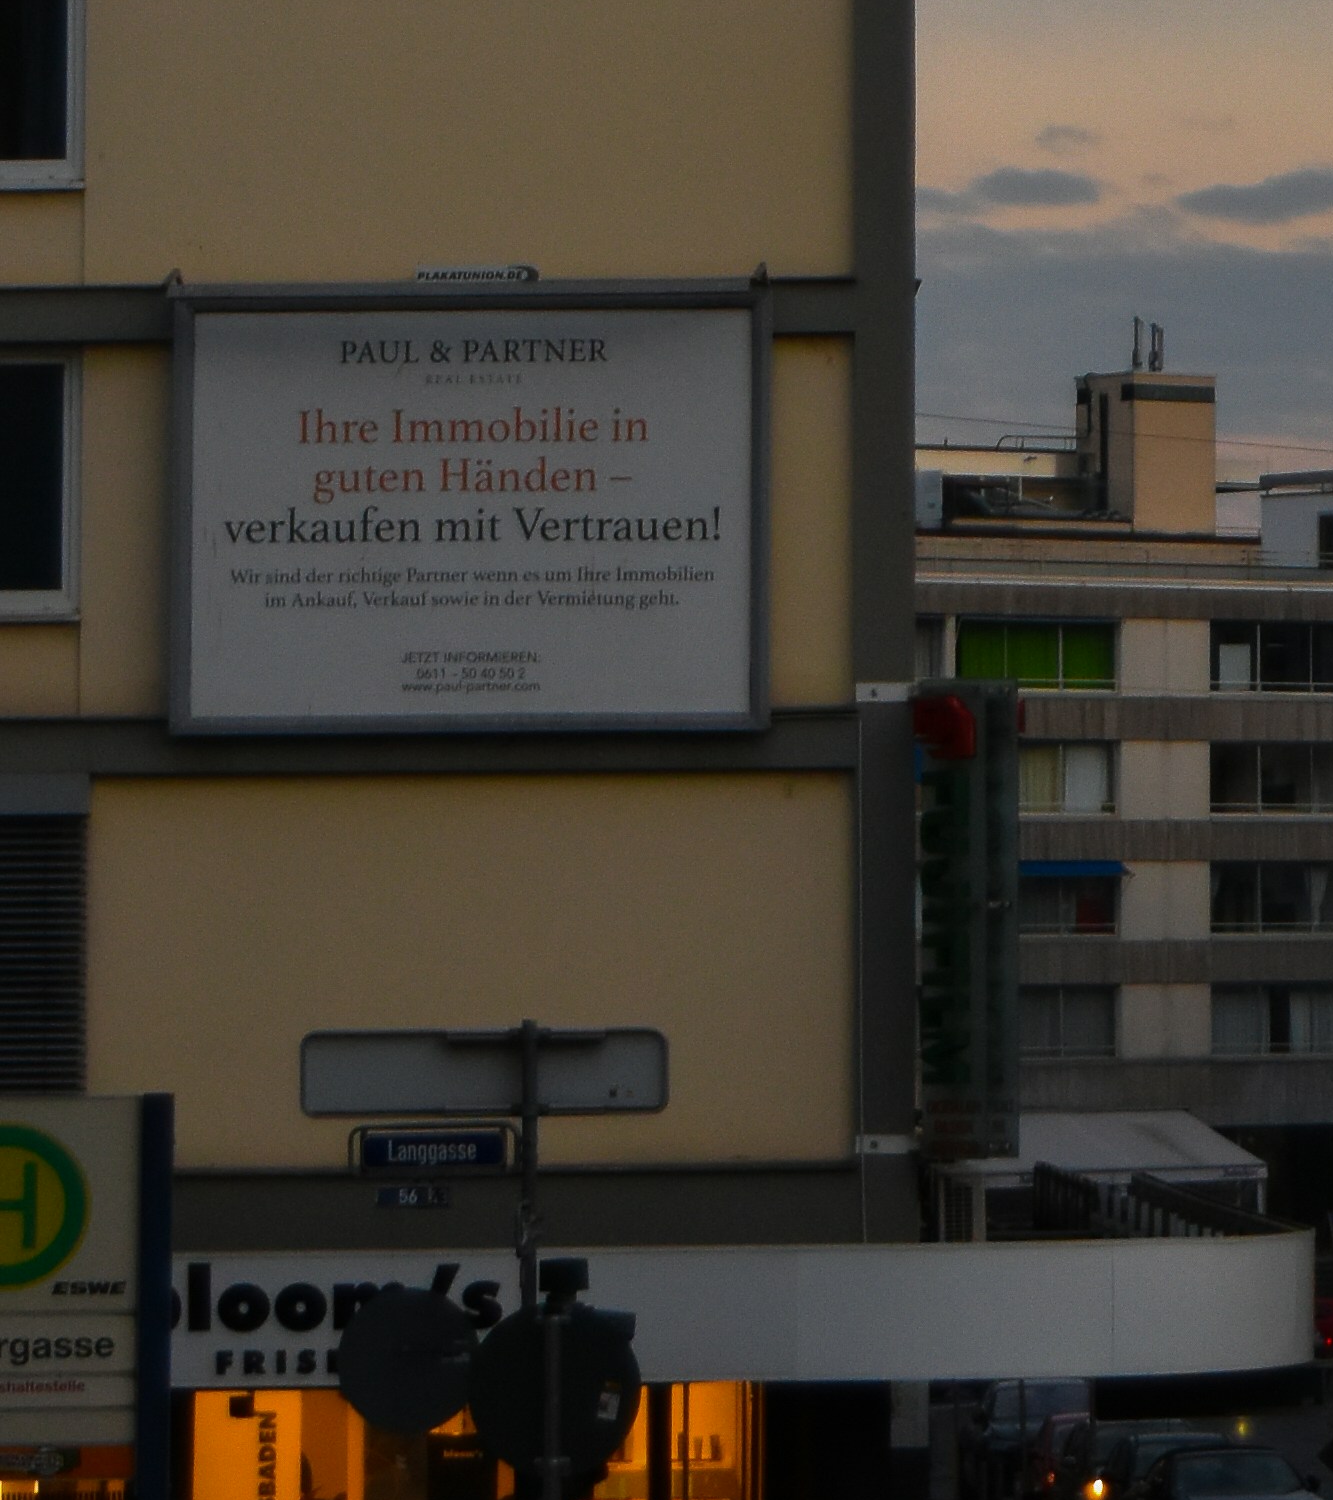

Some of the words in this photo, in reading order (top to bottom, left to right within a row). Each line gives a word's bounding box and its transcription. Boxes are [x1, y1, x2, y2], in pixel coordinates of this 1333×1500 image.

[417, 269, 523, 281] PLAKATUNION.DE
[340, 340, 419, 364] PAUL
[430, 340, 451, 363] &
[463, 339, 607, 362] PARTNER
[299, 408, 378, 443] Ihre
[392, 405, 599, 442] Immobilie
[611, 408, 649, 441] in
[313, 465, 425, 503] guten
[440, 455, 597, 492] Händen
[225, 505, 421, 543] verkaufen
[435, 508, 501, 542] mit
[513, 506, 721, 542] Vertrauen!
[231, 569, 259, 584] Wir
[265, 568, 300, 584] sind
[306, 568, 332, 583] der
[338, 567, 400, 587] richtige
[407, 567, 466, 582] Partner
[474, 570, 518, 582] wenn
[523, 571, 540, 582] es
[545, 570, 571, 582] um
[578, 567, 611, 582] Ihre
[616, 566, 715, 582] Immobilien
[265, 593, 286, 608] im
[291, 591, 357, 609] Ankauf,
[364, 591, 427, 607] Verkauf
[432, 593, 478, 606] sowie
[483, 591, 499, 606] in
[504, 591, 530, 606] der
[538, 590, 635, 609] Vermietung
[640, 589, 680, 610] geht.
[401, 651, 439, 664] JETZT
[416, 667, 446, 679] 0611
[462, 667, 477, 679] 50
[481, 667, 495, 679] 40
[500, 667, 515, 679] 50
[518, 667, 525, 679] 2
[921, 770, 972, 1085] FUJIFILM
[387, 1139, 478, 1165] Langgasse
[52, 1280, 127, 1295] ESWE
[171, 1262, 502, 1333] loom's
